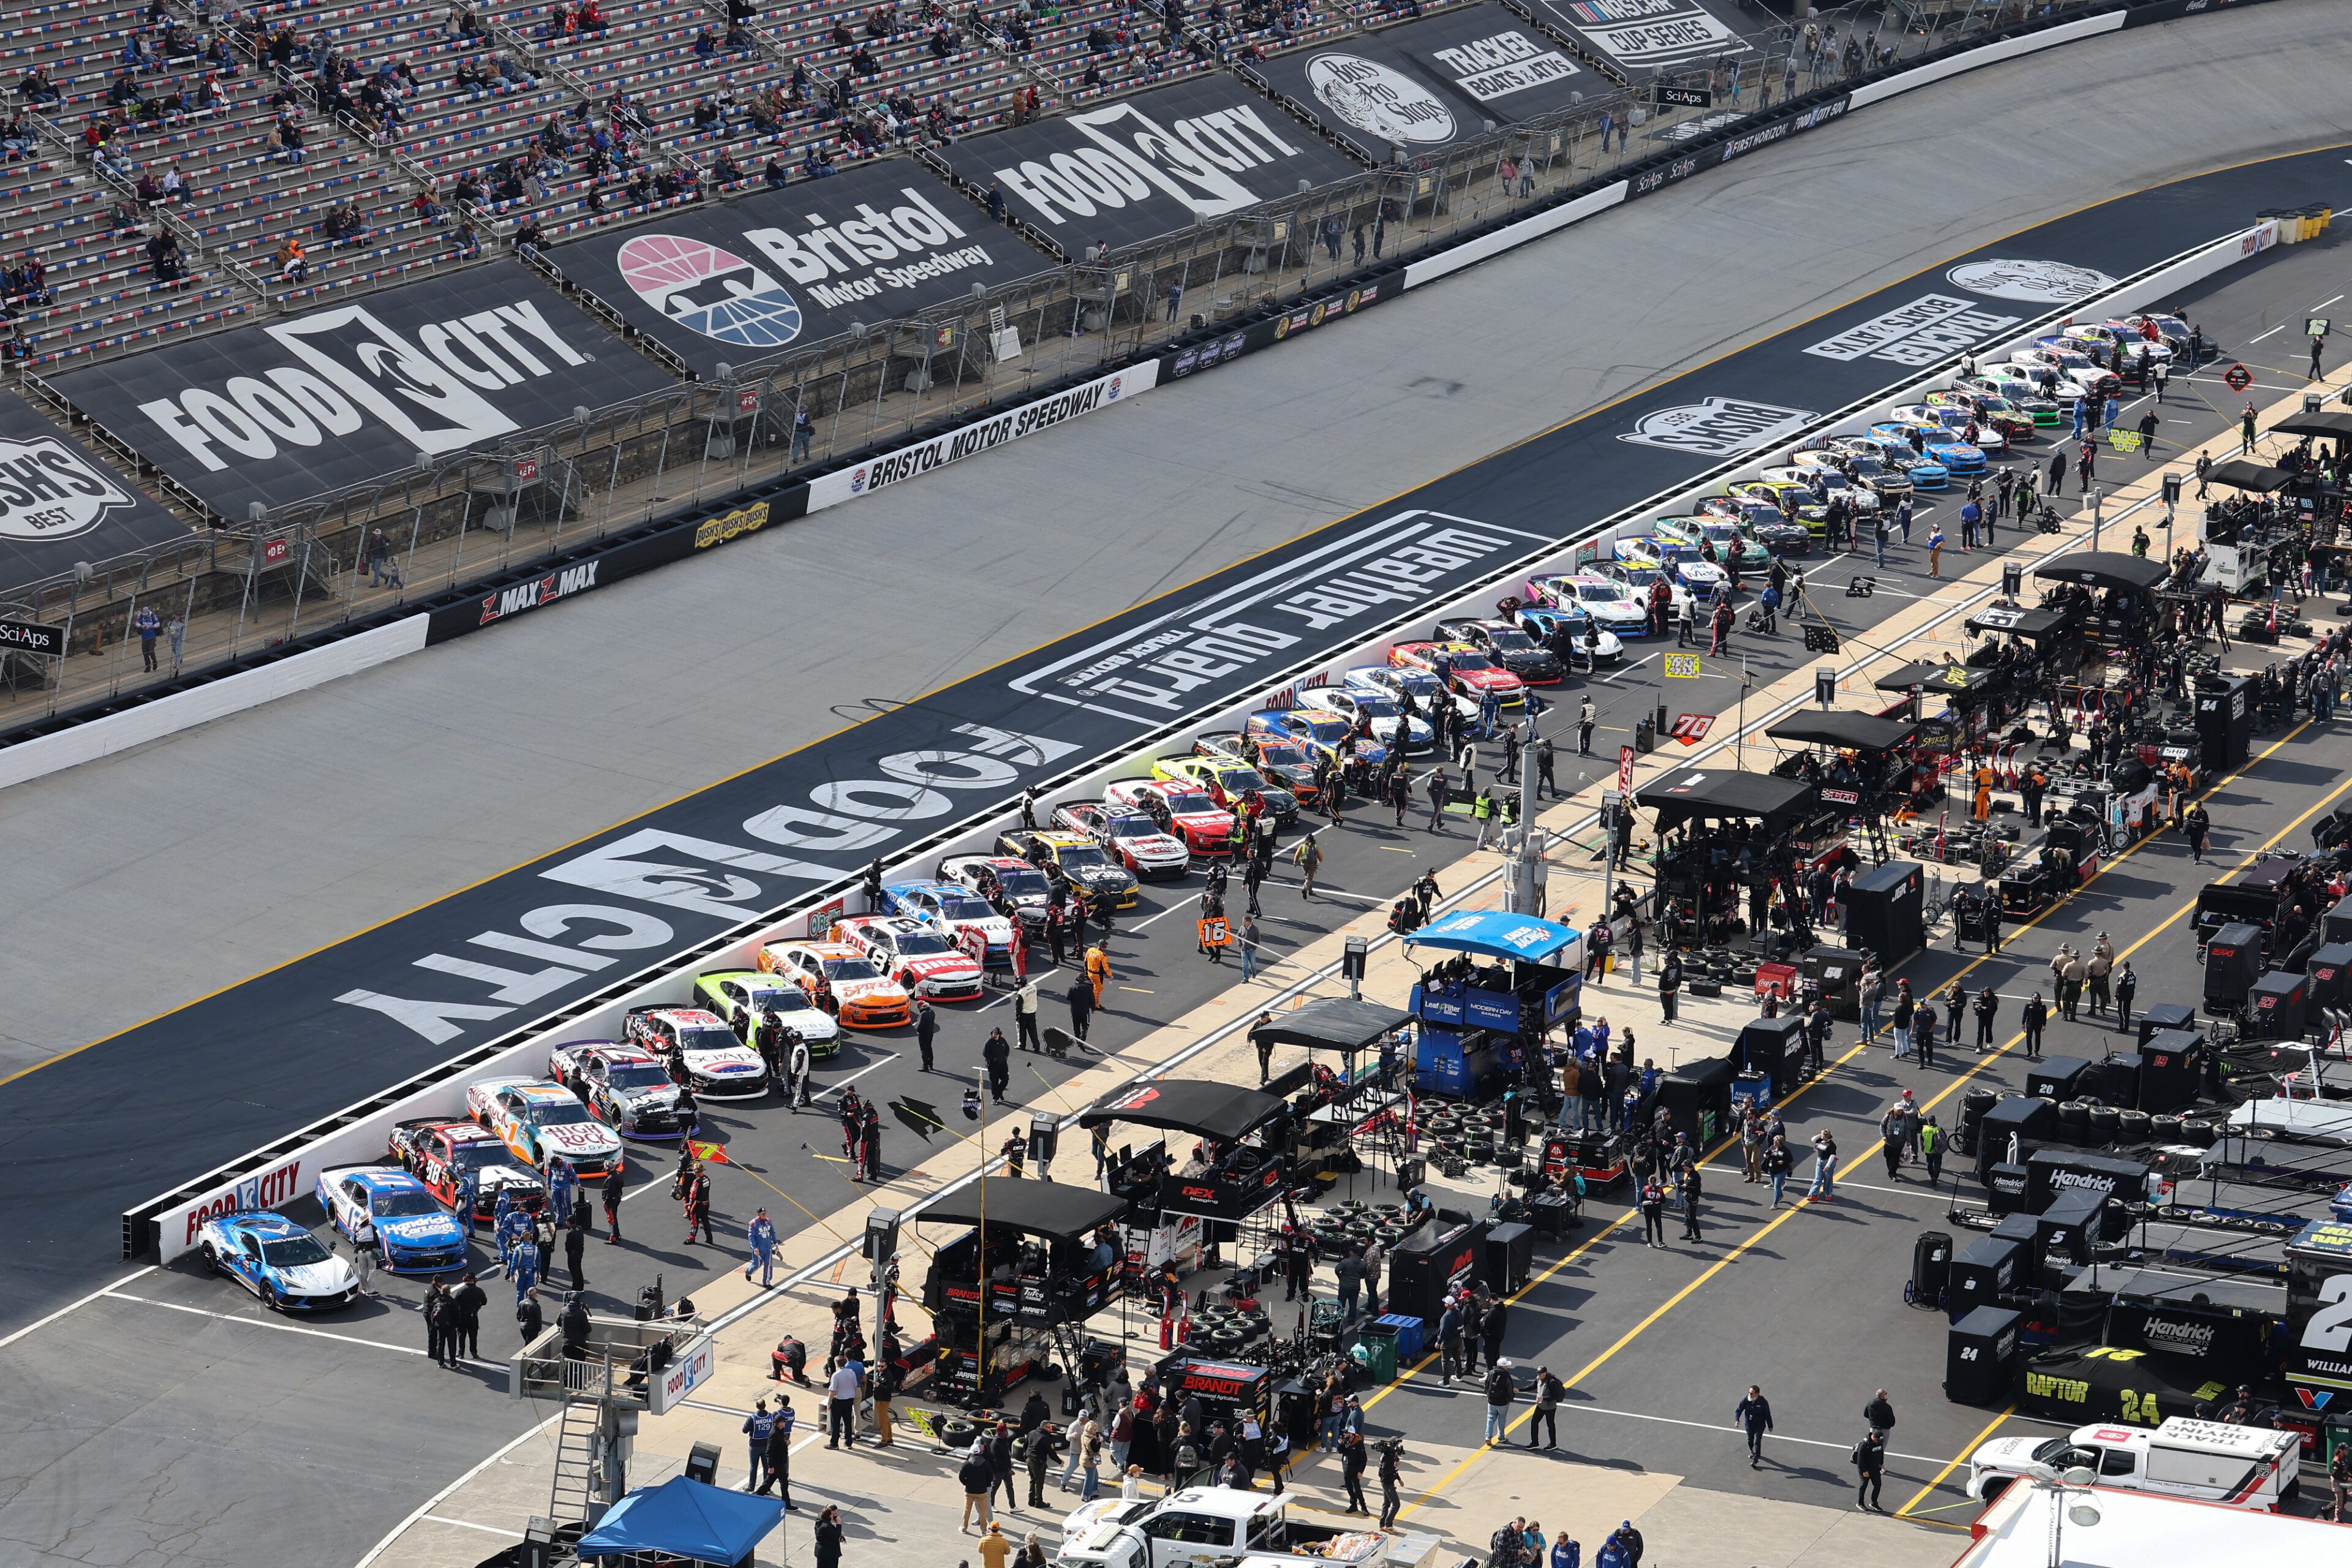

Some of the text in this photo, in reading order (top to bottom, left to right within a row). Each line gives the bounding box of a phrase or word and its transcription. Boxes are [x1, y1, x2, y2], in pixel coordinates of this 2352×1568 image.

[1608, 20, 1713, 51] CUP SERIES
[1433, 31, 1542, 76] TRACKER
[1322, 59, 1380, 85] Bass
[1466, 58, 1571, 97] BOATS & ATVs
[1352, 81, 1399, 105] Pro
[1667, 90, 1702, 104] SciAps
[1384, 99, 1448, 125] Shops
[1793, 100, 1845, 130] FOOD CITY 500
[1732, 137, 1754, 154] FIRST
[1752, 123, 1789, 146] HORIZON
[993, 105, 1299, 225] FOOD CITY
[1669, 159, 1695, 179] SciAps
[1637, 172, 1664, 192] SciAps
[742, 187, 967, 285] Bristol
[2241, 227, 2273, 257] FOOD CITY
[806, 245, 994, 310] Motor Speedway
[1362, 286, 1378, 298] TRACKER
[1327, 299, 1343, 311] TRACKER
[1879, 298, 1962, 329] BOATS
[1292, 312, 1308, 324] TRACKER
[2307, 318, 2328, 335] 16
[1868, 310, 2023, 366] TRACKER
[138, 300, 587, 472] FOOD CITY
[1648, 402, 1796, 451] BUSH'S
[1658, 411, 1698, 428] BEST
[868, 382, 1105, 491] BRISTOL MOTOR SPEEDWAY
[0, 450, 107, 518] SH'S
[23, 507, 76, 530] BEST
[721, 513, 744, 534] BUSH'S
[745, 505, 768, 525] BUSH'S
[696, 522, 719, 543] BUSH'S
[0, 625, 50, 647] SciAps
[1057, 629, 1194, 687] TRUCK BOXES
[2200, 699, 2219, 711] 24
[1675, 714, 1715, 737] 70
[1920, 734, 1949, 747] SPIKED
[1159, 764, 1196, 785] MENARDS
[333, 722, 1084, 1045] FOOD CITY
[1891, 882, 1907, 903] JGR
[1202, 921, 1226, 943] 16
[1501, 926, 1532, 941] KAULIG
[872, 950, 888, 973] 8
[1823, 967, 1843, 980] 54
[2315, 968, 2335, 981] 45
[1425, 1000, 1461, 1013] Leaf Filter
[1470, 1003, 1499, 1014] MODERN
[2257, 996, 2277, 1009] 23
[1785, 1030, 1800, 1047] KAULIG
[688, 1050, 761, 1064] SciAps
[2153, 1055, 2169, 1067] 19
[2038, 1084, 2054, 1095] 20
[545, 1123, 603, 1138] HIGH
[558, 1133, 619, 1148] ROCK
[693, 1142, 720, 1159] 7
[426, 1158, 442, 1186] 88
[1263, 1169, 1277, 1186] DEX
[1994, 1176, 2026, 1187] Hendrick
[2048, 1169, 2116, 1192] Hendrick
[260, 1161, 301, 1208] CITY
[1182, 1185, 1216, 1199] DEX
[383, 1214, 452, 1235] Hendrick
[401, 1221, 456, 1238] Cars.com
[262, 1232, 312, 1245] CHEVROLET
[2049, 1231, 2067, 1244] 5
[2044, 1254, 2073, 1265] Hendrick
[1106, 1265, 1113, 1281] 7
[992, 1284, 1018, 1294] BRANDT
[1023, 1286, 1044, 1298] Tufco
[1964, 1280, 1977, 1290] 9
[1020, 1305, 1047, 1316] JARRETT
[2142, 1316, 2215, 1341] Hendrick
[2154, 1333, 2210, 1346] MOTORSPORTS
[939, 1348, 952, 1360] 7
[1960, 1346, 1978, 1362] 24
[667, 1352, 706, 1396] FOOD CITY
[1182, 1376, 1245, 1395] BRANDT
[2027, 1371, 2089, 1403] RAPTOR
[1191, 1391, 1216, 1401] Professional
[2120, 1389, 2161, 1425] 24
[2164, 1424, 2254, 1441] DRYING
[2181, 1419, 2251, 1432] TEAM
[2165, 1431, 2240, 1446] TRACK
